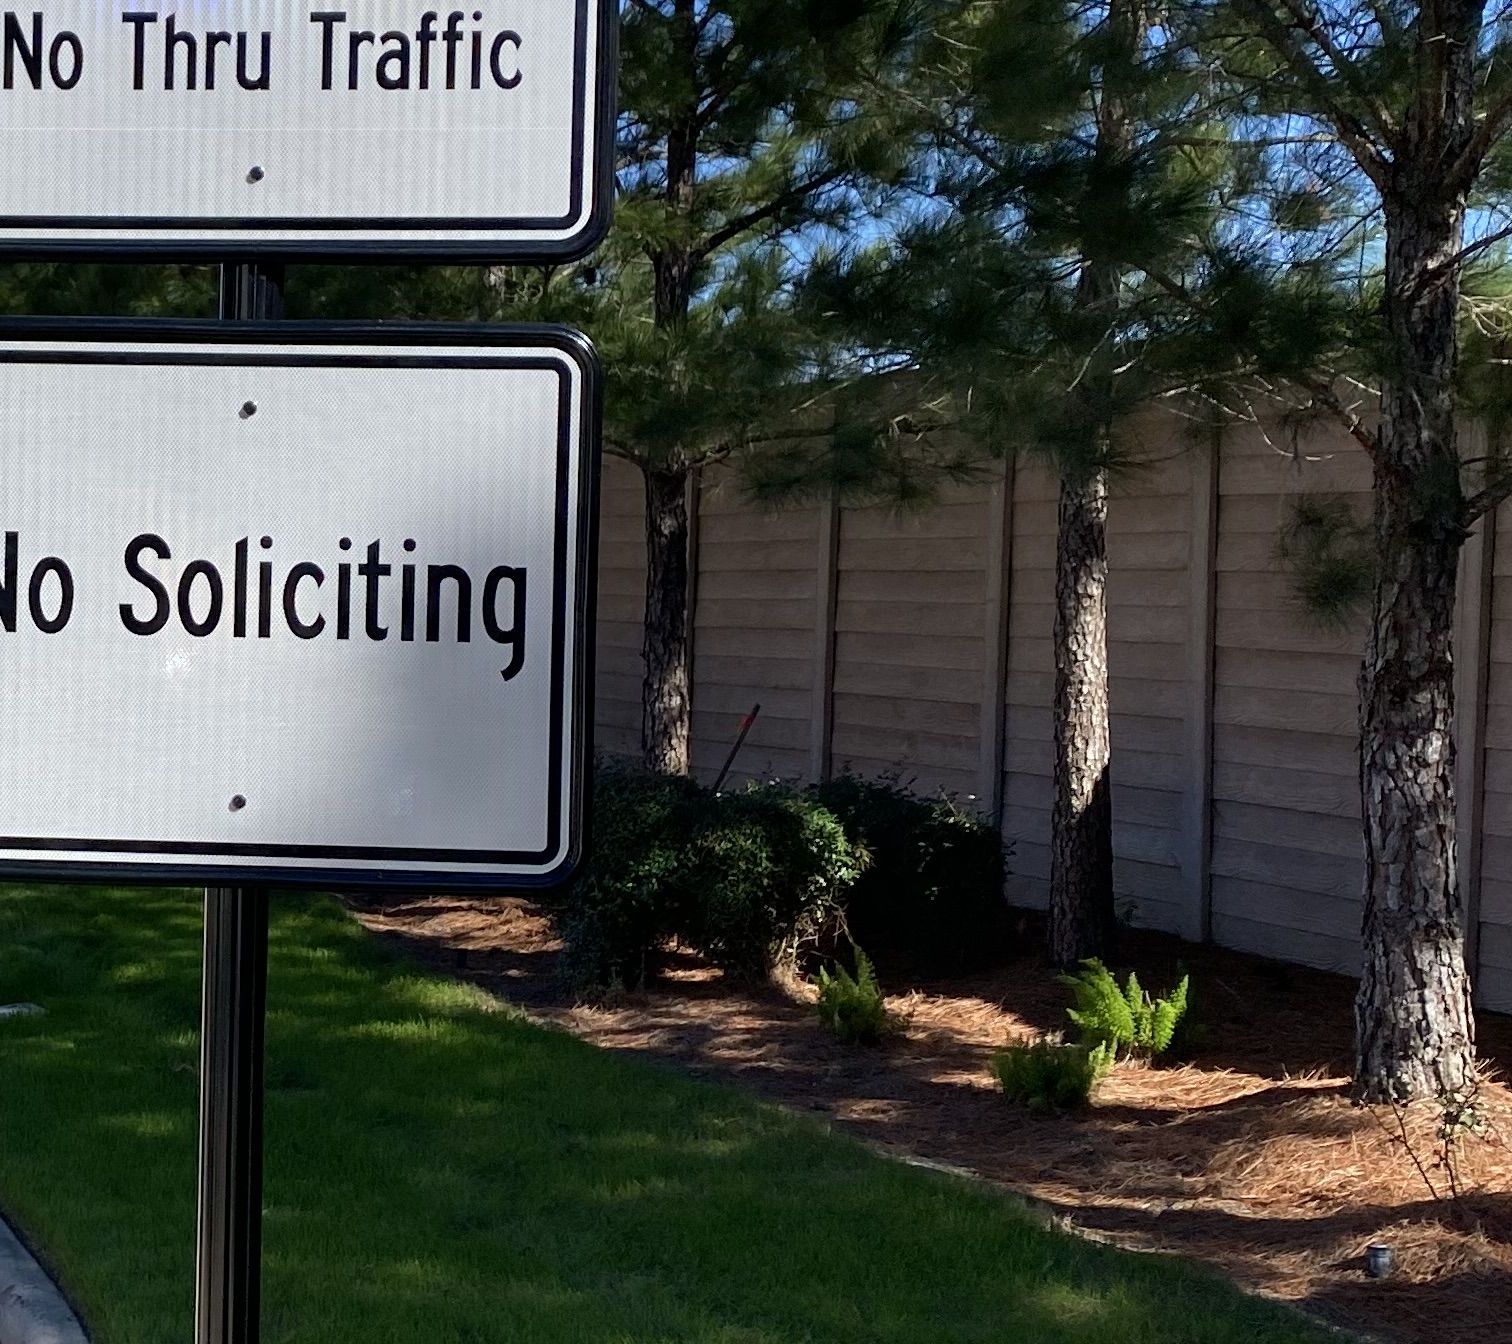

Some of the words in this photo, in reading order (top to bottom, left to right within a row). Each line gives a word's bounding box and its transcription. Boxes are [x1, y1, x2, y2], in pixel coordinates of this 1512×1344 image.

[3, 11, 84, 90] No
[122, 11, 271, 91] Thru
[310, 11, 523, 91] Traffic
[119, 533, 527, 682] Soliciting
